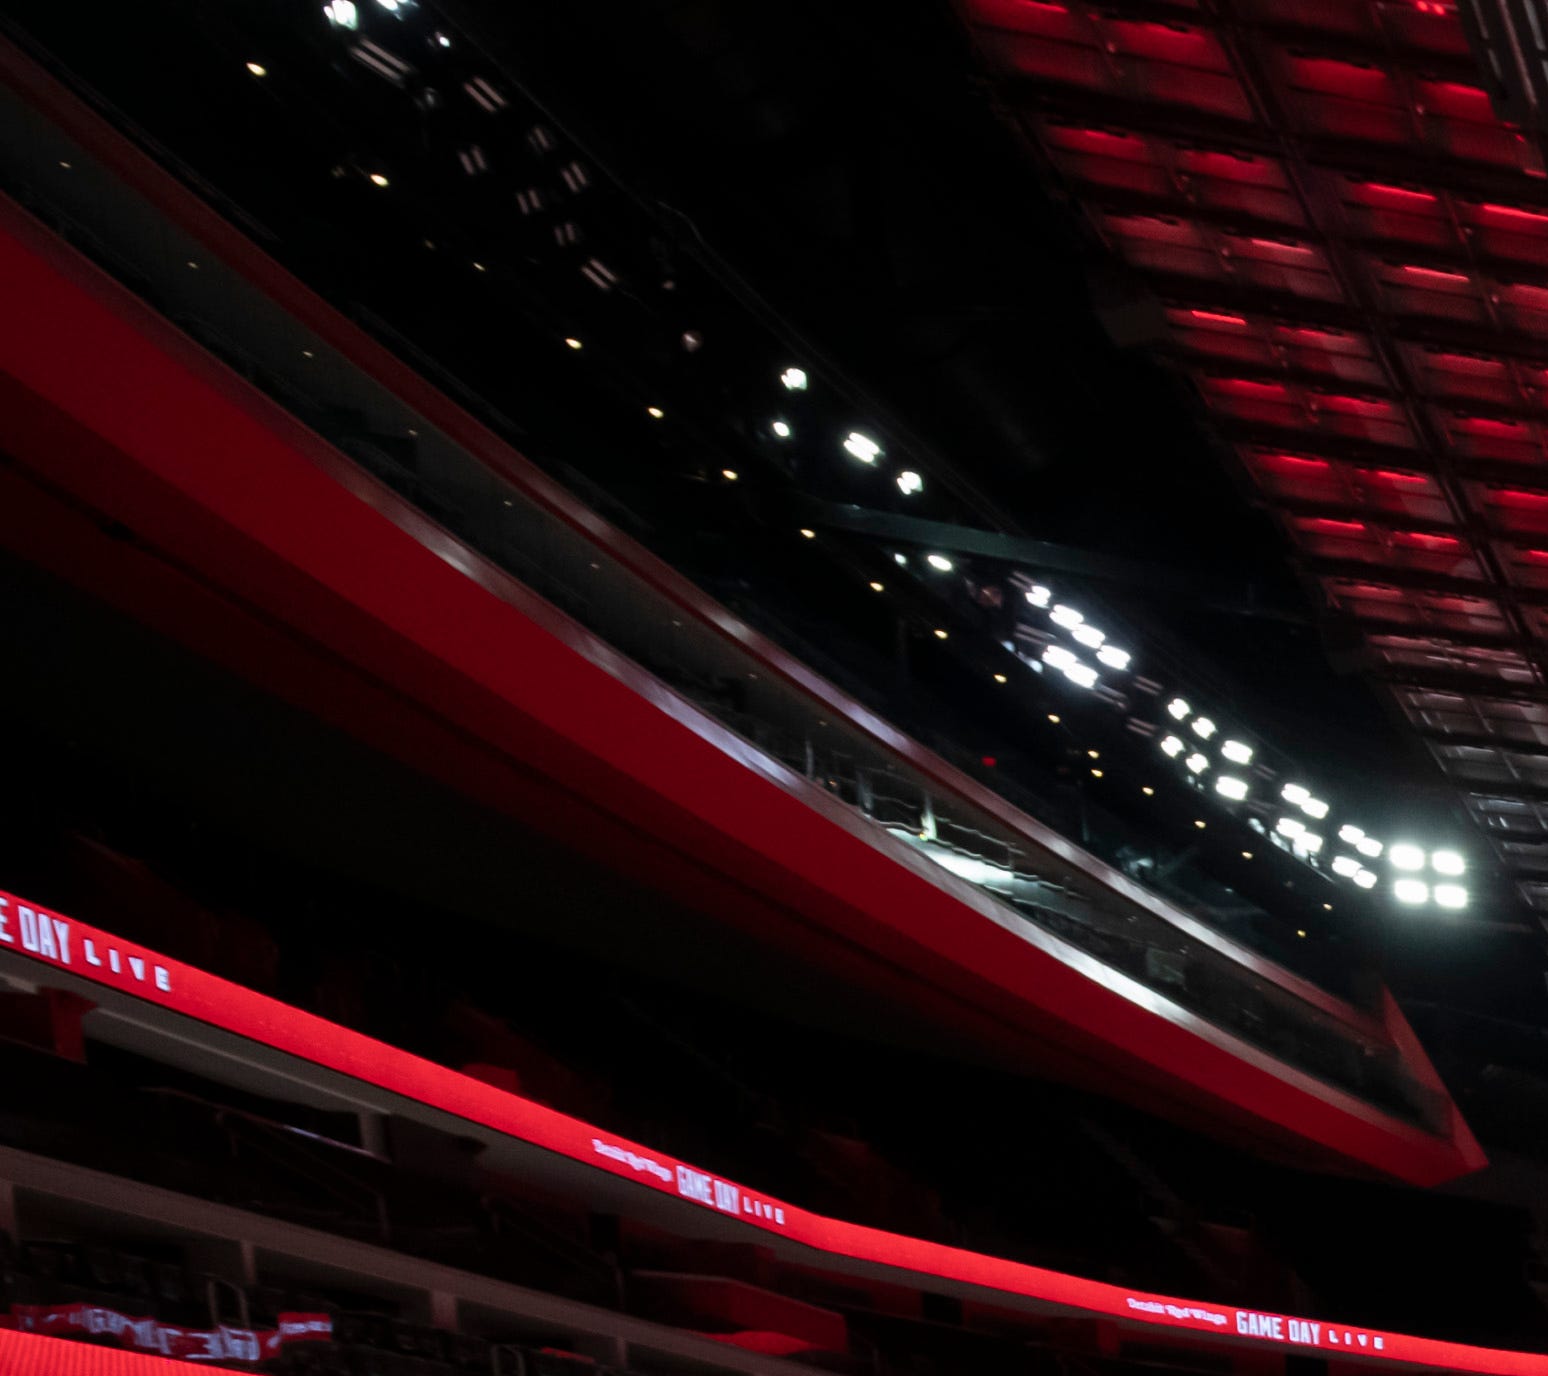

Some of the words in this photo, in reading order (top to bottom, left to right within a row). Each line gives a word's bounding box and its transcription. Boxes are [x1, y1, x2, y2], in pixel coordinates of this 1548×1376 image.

[18, 905, 70, 964] DAY
[83, 939, 170, 992] LIVE
[1236, 1311, 1284, 1339] GAME
[1288, 1320, 1320, 1345] DAY
[1328, 1330, 1384, 1350] LIVE
